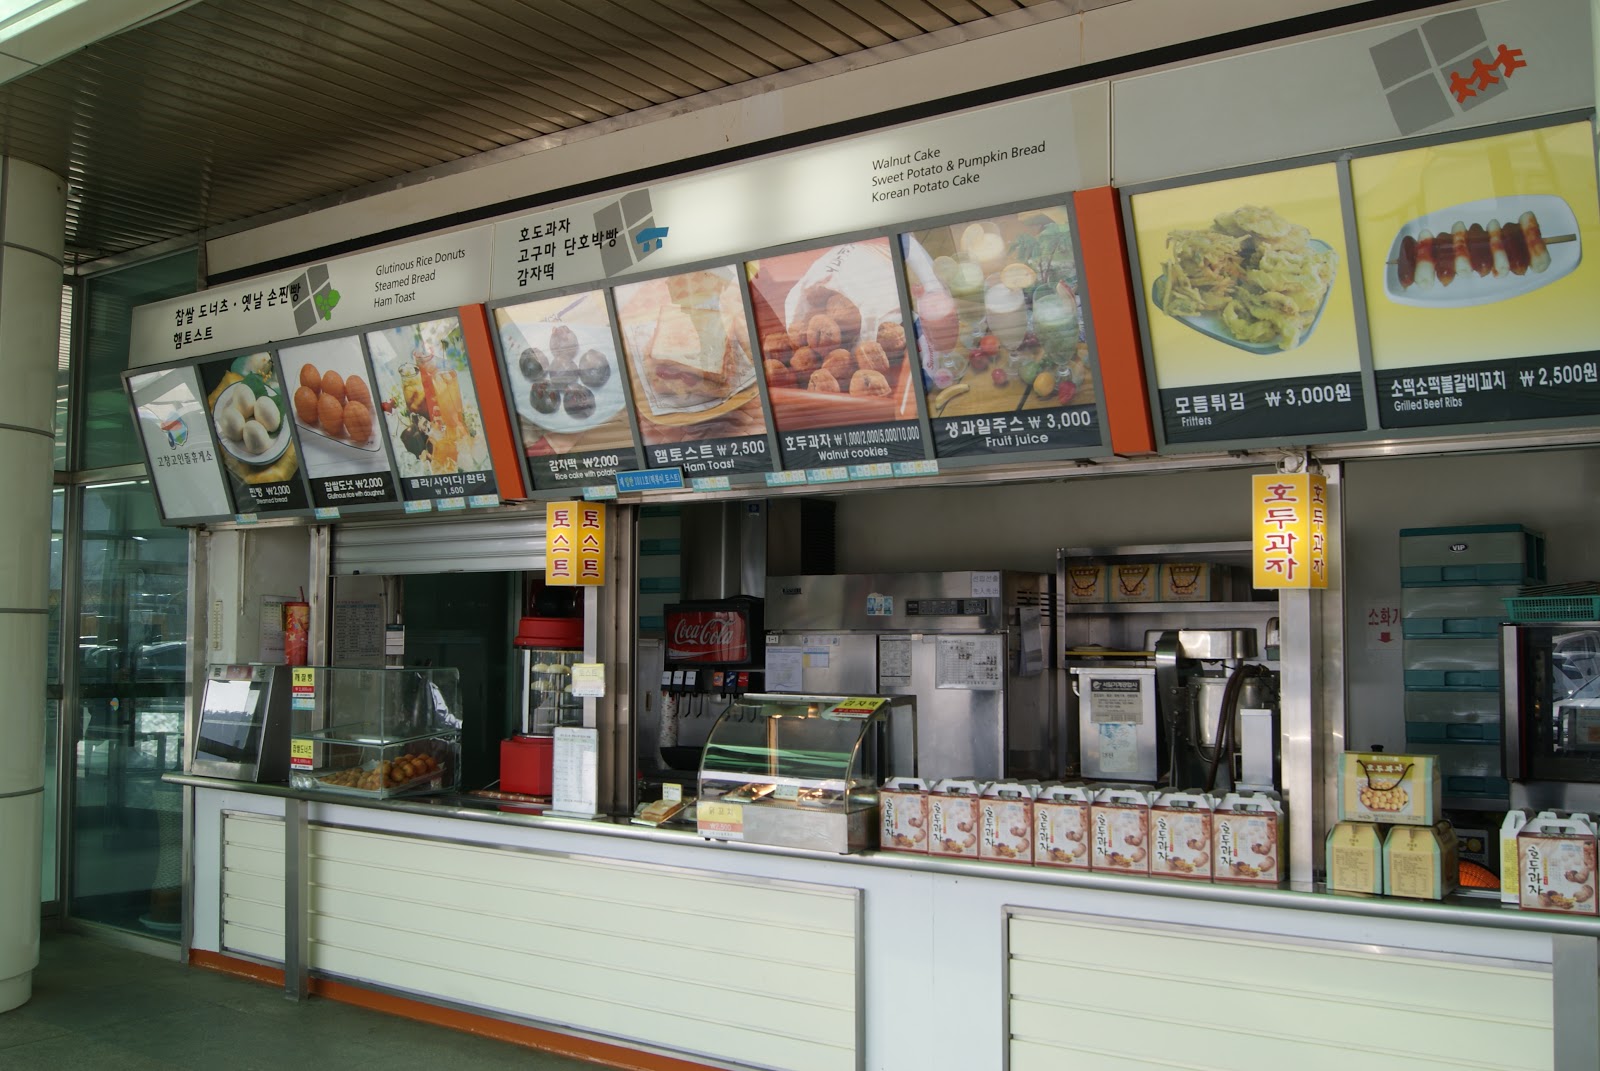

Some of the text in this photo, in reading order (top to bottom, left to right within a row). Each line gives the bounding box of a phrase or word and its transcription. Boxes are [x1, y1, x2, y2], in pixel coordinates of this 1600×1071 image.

[872, 148, 941, 171] Walnut Cake
[872, 141, 1046, 188] Sweet Potato & Pumpkin Bread
[872, 172, 981, 203] Korean Potato Cake
[518, 218, 571, 243] 호도과자
[517, 227, 619, 263] 고구마 단호박빵
[375, 248, 466, 277] Glutinous Rice Donuts
[517, 262, 555, 287] 감자떡
[374, 270, 436, 292] Steamed Bread
[175, 283, 301, 326] 찹쌀 도너츠 옛날 손찐빵
[373, 290, 416, 308] Ham Toast
[173, 326, 214, 350] 햄토스트
[1391, 370, 1507, 399] 소떡소떡불갈비꼬치
[1539, 362, 1599, 385] 2,500원
[1175, 392, 1246, 416] 모듬튀김
[1285, 383, 1352, 406] 3,000원
[1393, 396, 1463, 412] Grilled Beef Ribs
[944, 415, 1024, 440] 생과일주스
[1046, 410, 1091, 430] 3,000
[1181, 414, 1212, 427] Fritters
[654, 444, 713, 464] 햄토스트
[730, 440, 765, 457] 2,500
[784, 434, 831, 453] 호두과자
[985, 432, 1049, 448] Fruit juice
[157, 451, 213, 467] 고창고인돌휴게소
[549, 457, 578, 472] 감자떡
[683, 458, 735, 473] Ham Toast
[818, 446, 889, 461] Walnut cookies
[410, 473, 486, 489] 콜라/사이다/환타
[554, 468, 617, 481] Rice cake with potato
[249, 487, 263, 498] 찐빵
[443, 486, 464, 496] 1,500
[551, 510, 571, 577] 토스트
[582, 510, 601, 577] 토스트
[1263, 482, 1300, 582] 호두과자
[1312, 483, 1326, 582] 호두과자
[673, 617, 734, 646] Coca-Cola
[1221, 822, 1233, 866] 호두과자
[1528, 846, 1544, 895] 호두과자
